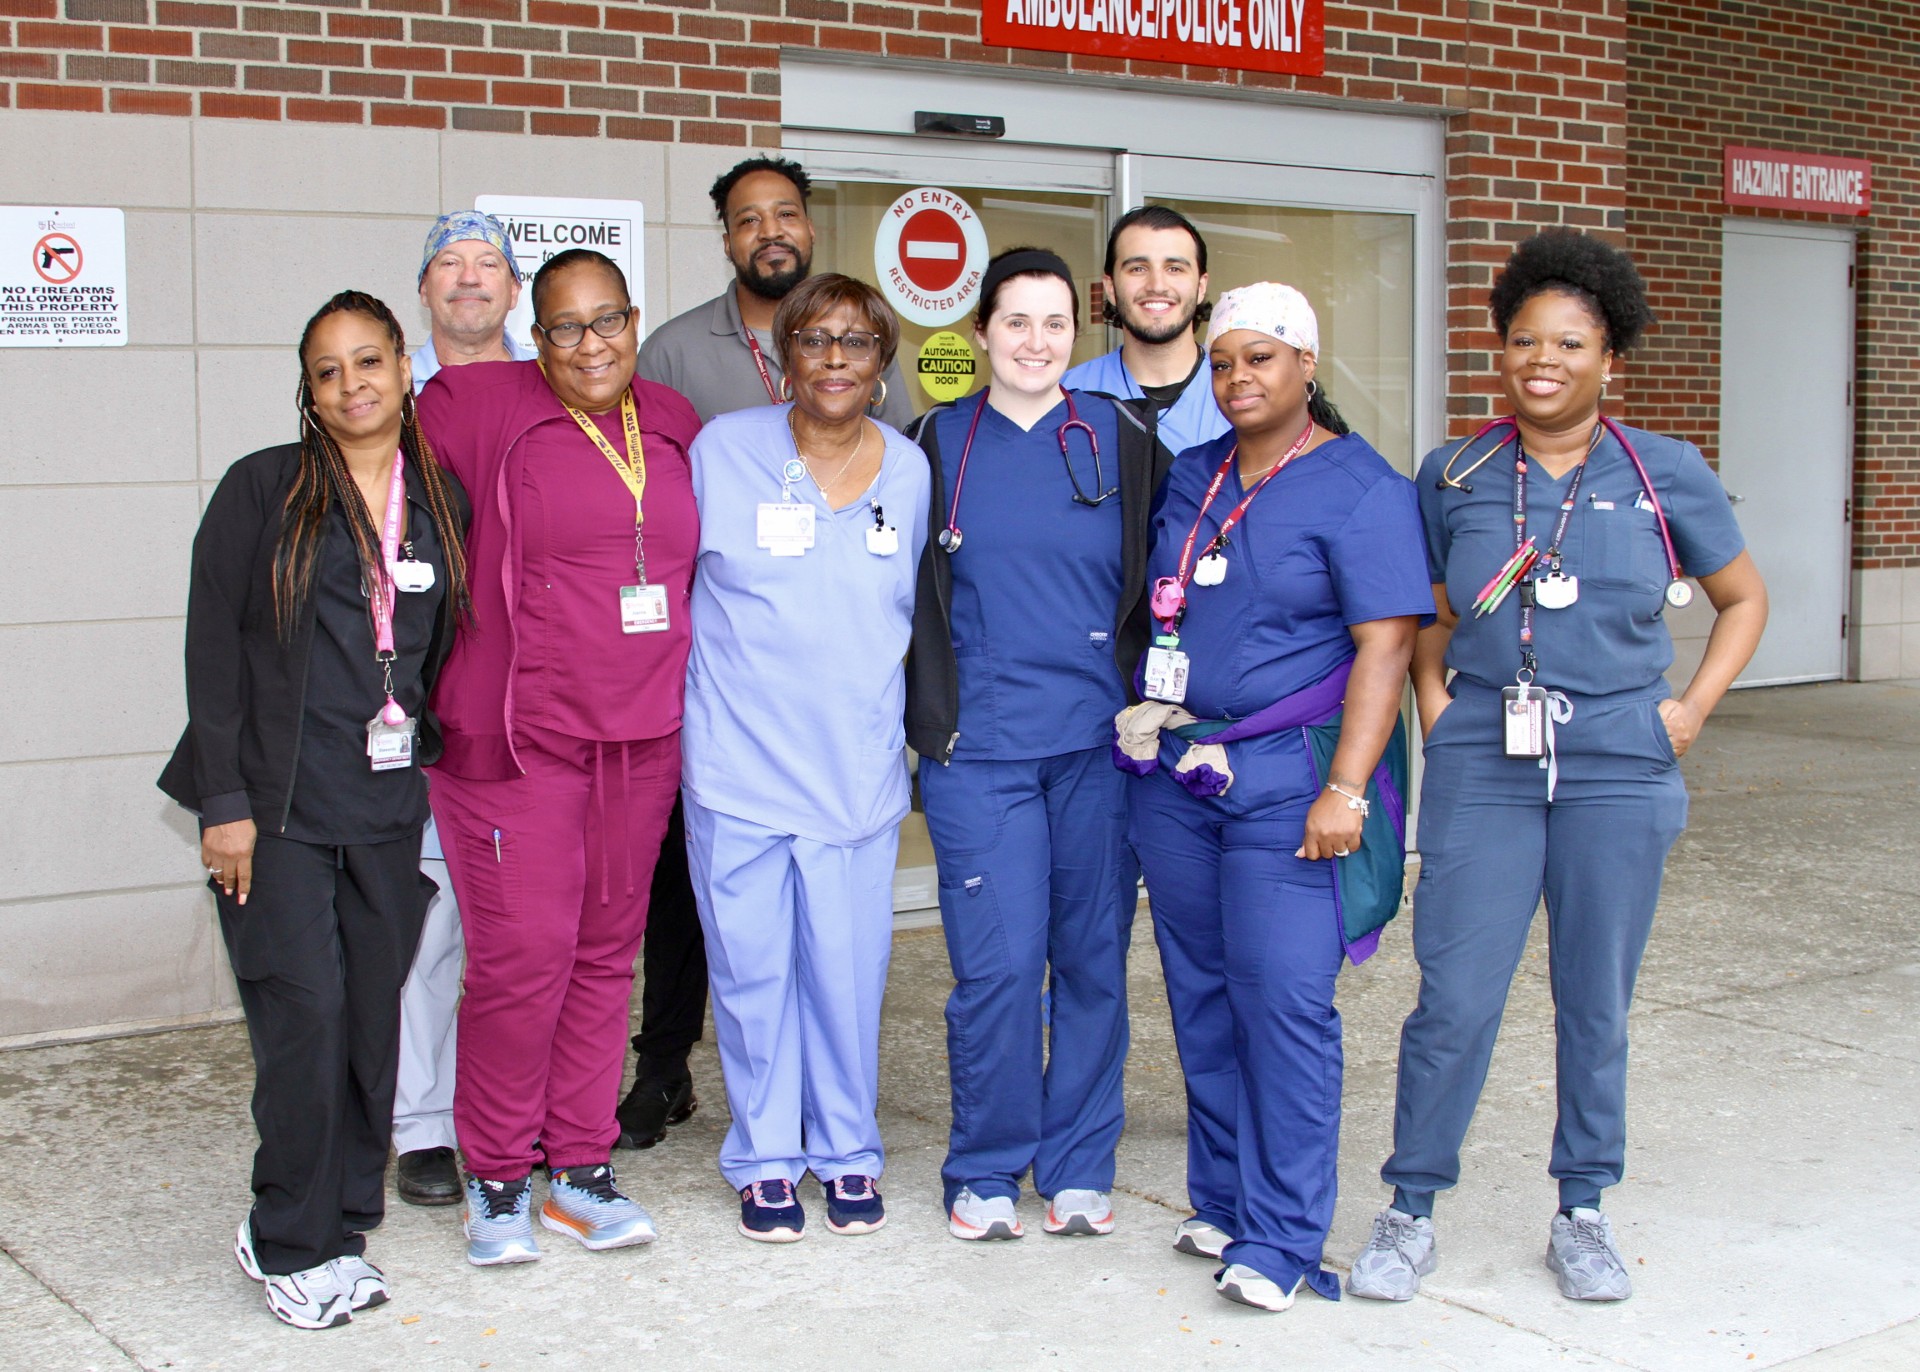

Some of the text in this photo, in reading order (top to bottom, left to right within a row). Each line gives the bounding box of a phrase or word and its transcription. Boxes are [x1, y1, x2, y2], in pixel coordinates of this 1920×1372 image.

[1248, 0, 1305, 53] ONLY
[1732, 159, 1863, 205] HAZMAT ENTRANCE
[893, 191, 972, 221] NO ENTRY
[501, 222, 621, 245] WELCOME
[2, 286, 115, 294] NO FIREARMS
[5, 295, 113, 303] ALLOWED ON
[888, 266, 980, 311] RESTRICTED AREA
[0, 303, 119, 311] THIS PROPERTY
[924, 347, 970, 357] AUTOMATIC
[921, 360, 973, 373] CAUTION
[935, 376, 959, 385] DOOR
[572, 409, 593, 429] STAT
[625, 412, 636, 432] STAT
[630, 432, 641, 464] Staffing
[1278, 446, 1299, 468] Hospital
[634, 465, 644, 485] Safe
[1209, 472, 1224, 495] Hospital
[1178, 538, 1195, 578] Community
